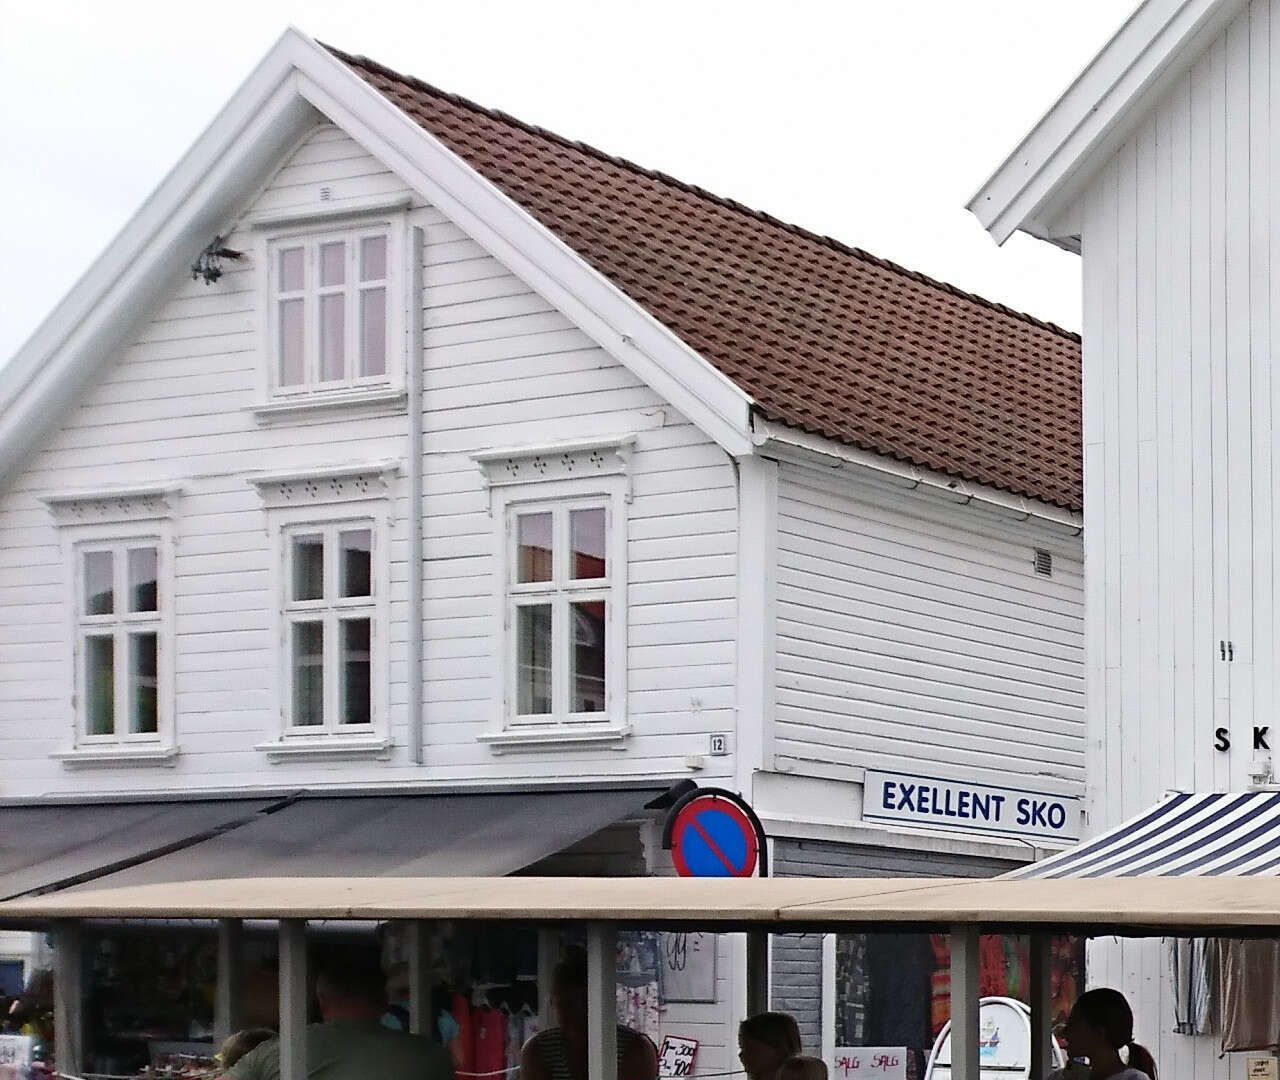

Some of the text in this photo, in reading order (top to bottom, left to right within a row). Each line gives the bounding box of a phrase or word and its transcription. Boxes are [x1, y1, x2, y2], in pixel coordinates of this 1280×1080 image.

[713, 738, 723, 751] 12
[882, 781, 1066, 829] EXELLENT SKO
